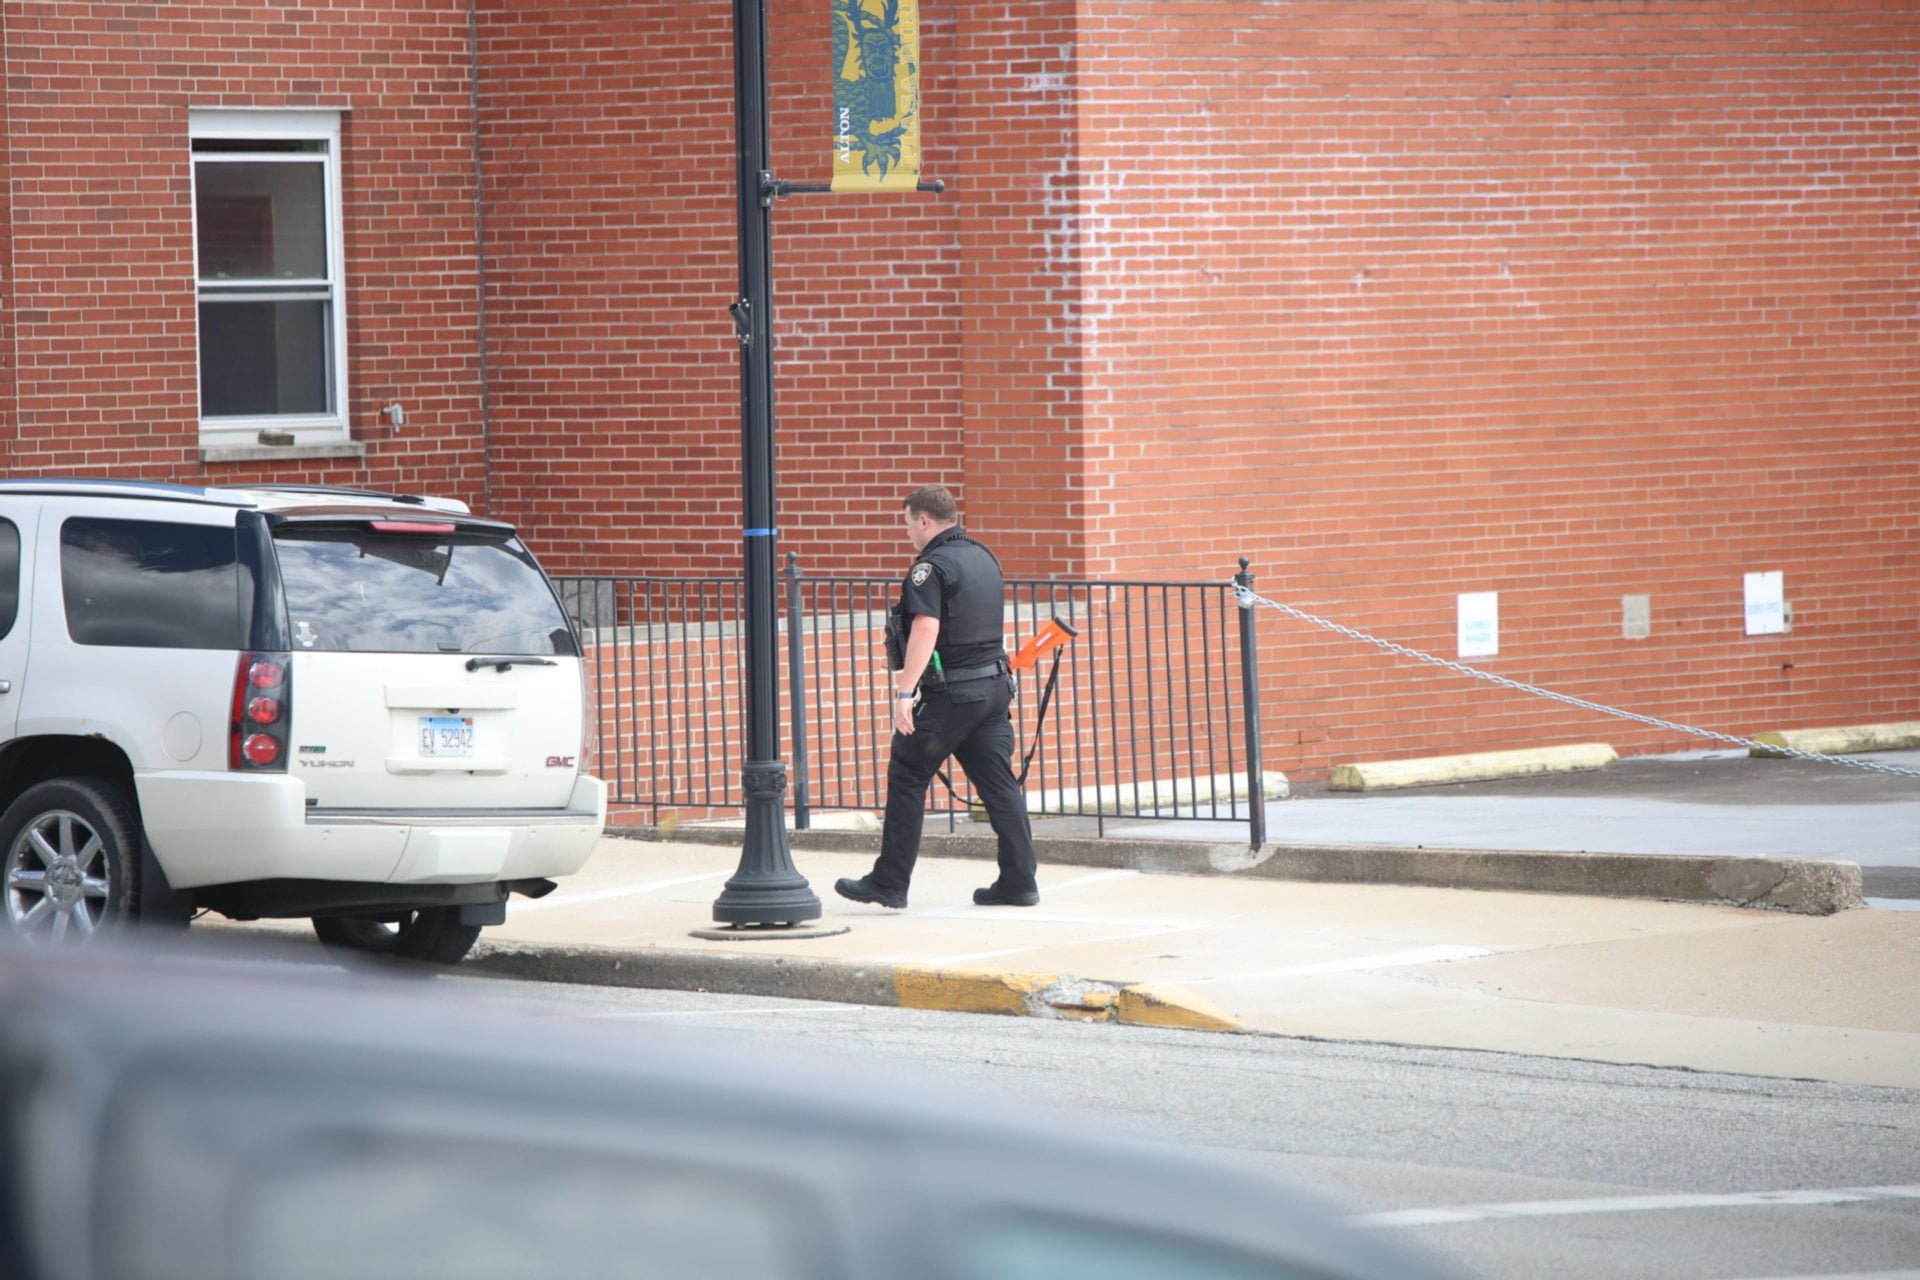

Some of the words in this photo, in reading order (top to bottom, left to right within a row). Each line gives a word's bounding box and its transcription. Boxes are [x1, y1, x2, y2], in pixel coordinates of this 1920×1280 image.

[839, 107, 850, 164] ALTON
[441, 728, 473, 748] 52942
[545, 756, 575, 768] GMC
